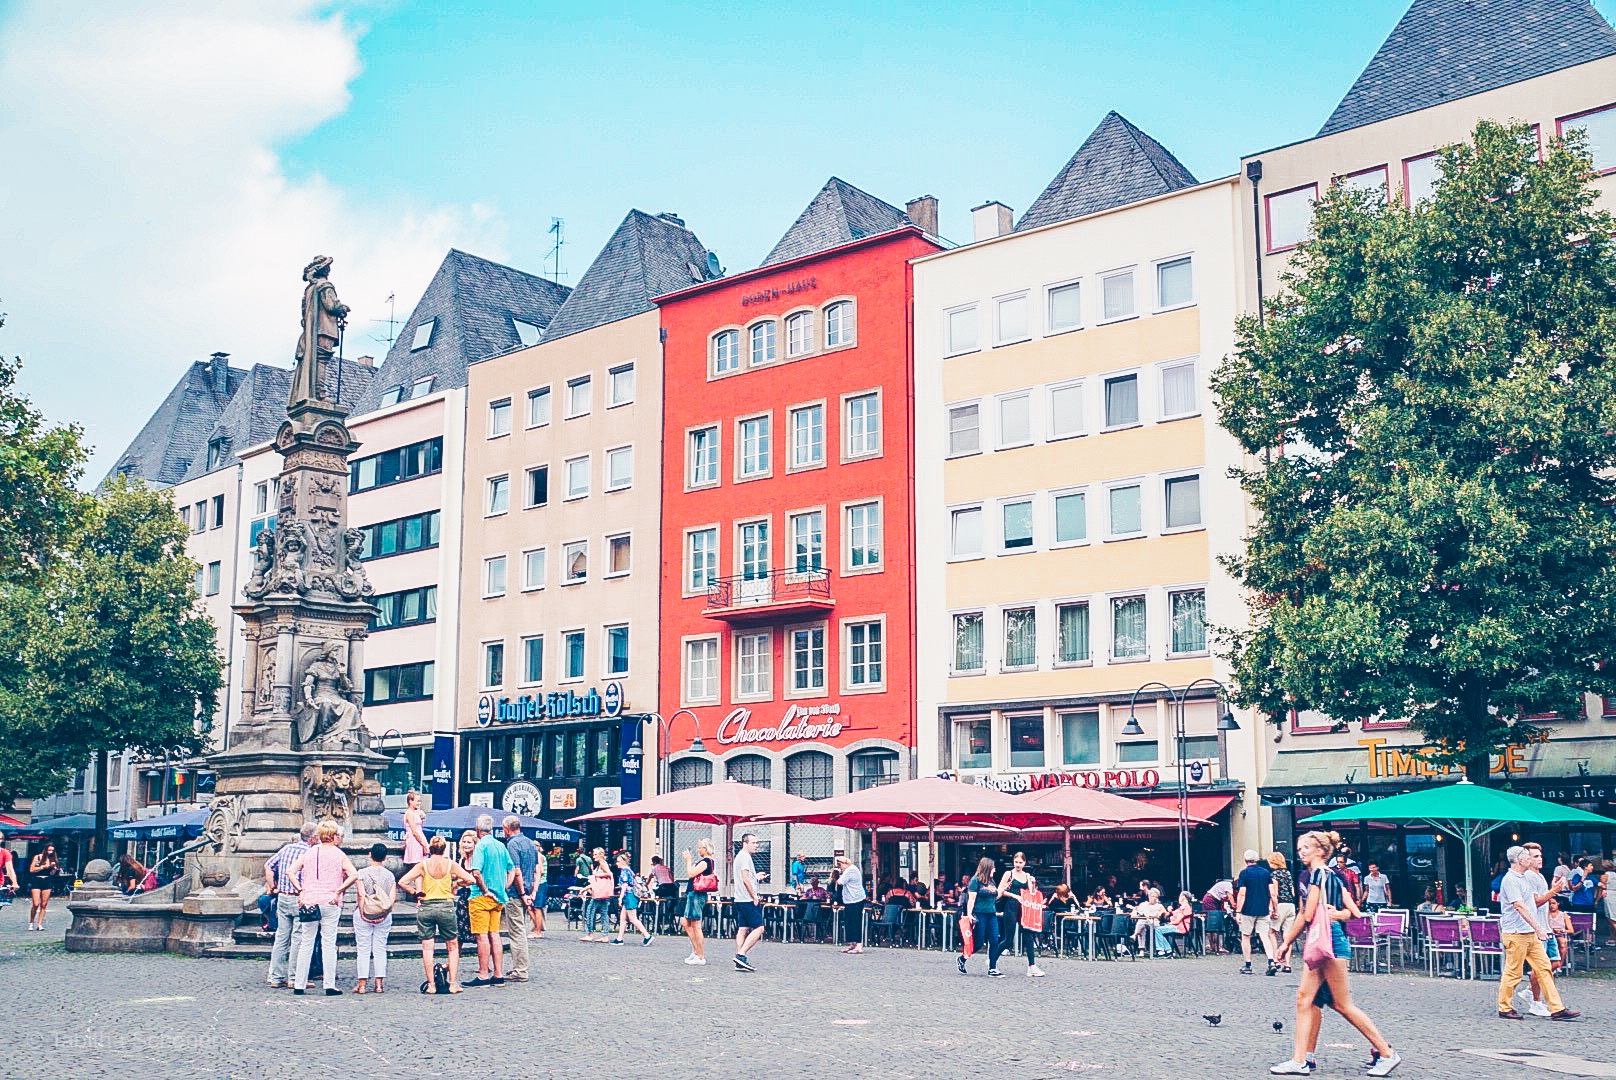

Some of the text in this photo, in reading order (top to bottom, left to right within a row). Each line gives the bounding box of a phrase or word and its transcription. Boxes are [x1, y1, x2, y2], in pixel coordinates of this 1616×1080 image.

[717, 704, 843, 745] Chocolaterie
[1358, 736, 1528, 778] TIMEDE
[1103, 769, 1160, 788] POLO
[1332, 794, 1349, 804] im
[1542, 788, 1565, 798] ins
[1574, 787, 1605, 798] alte
